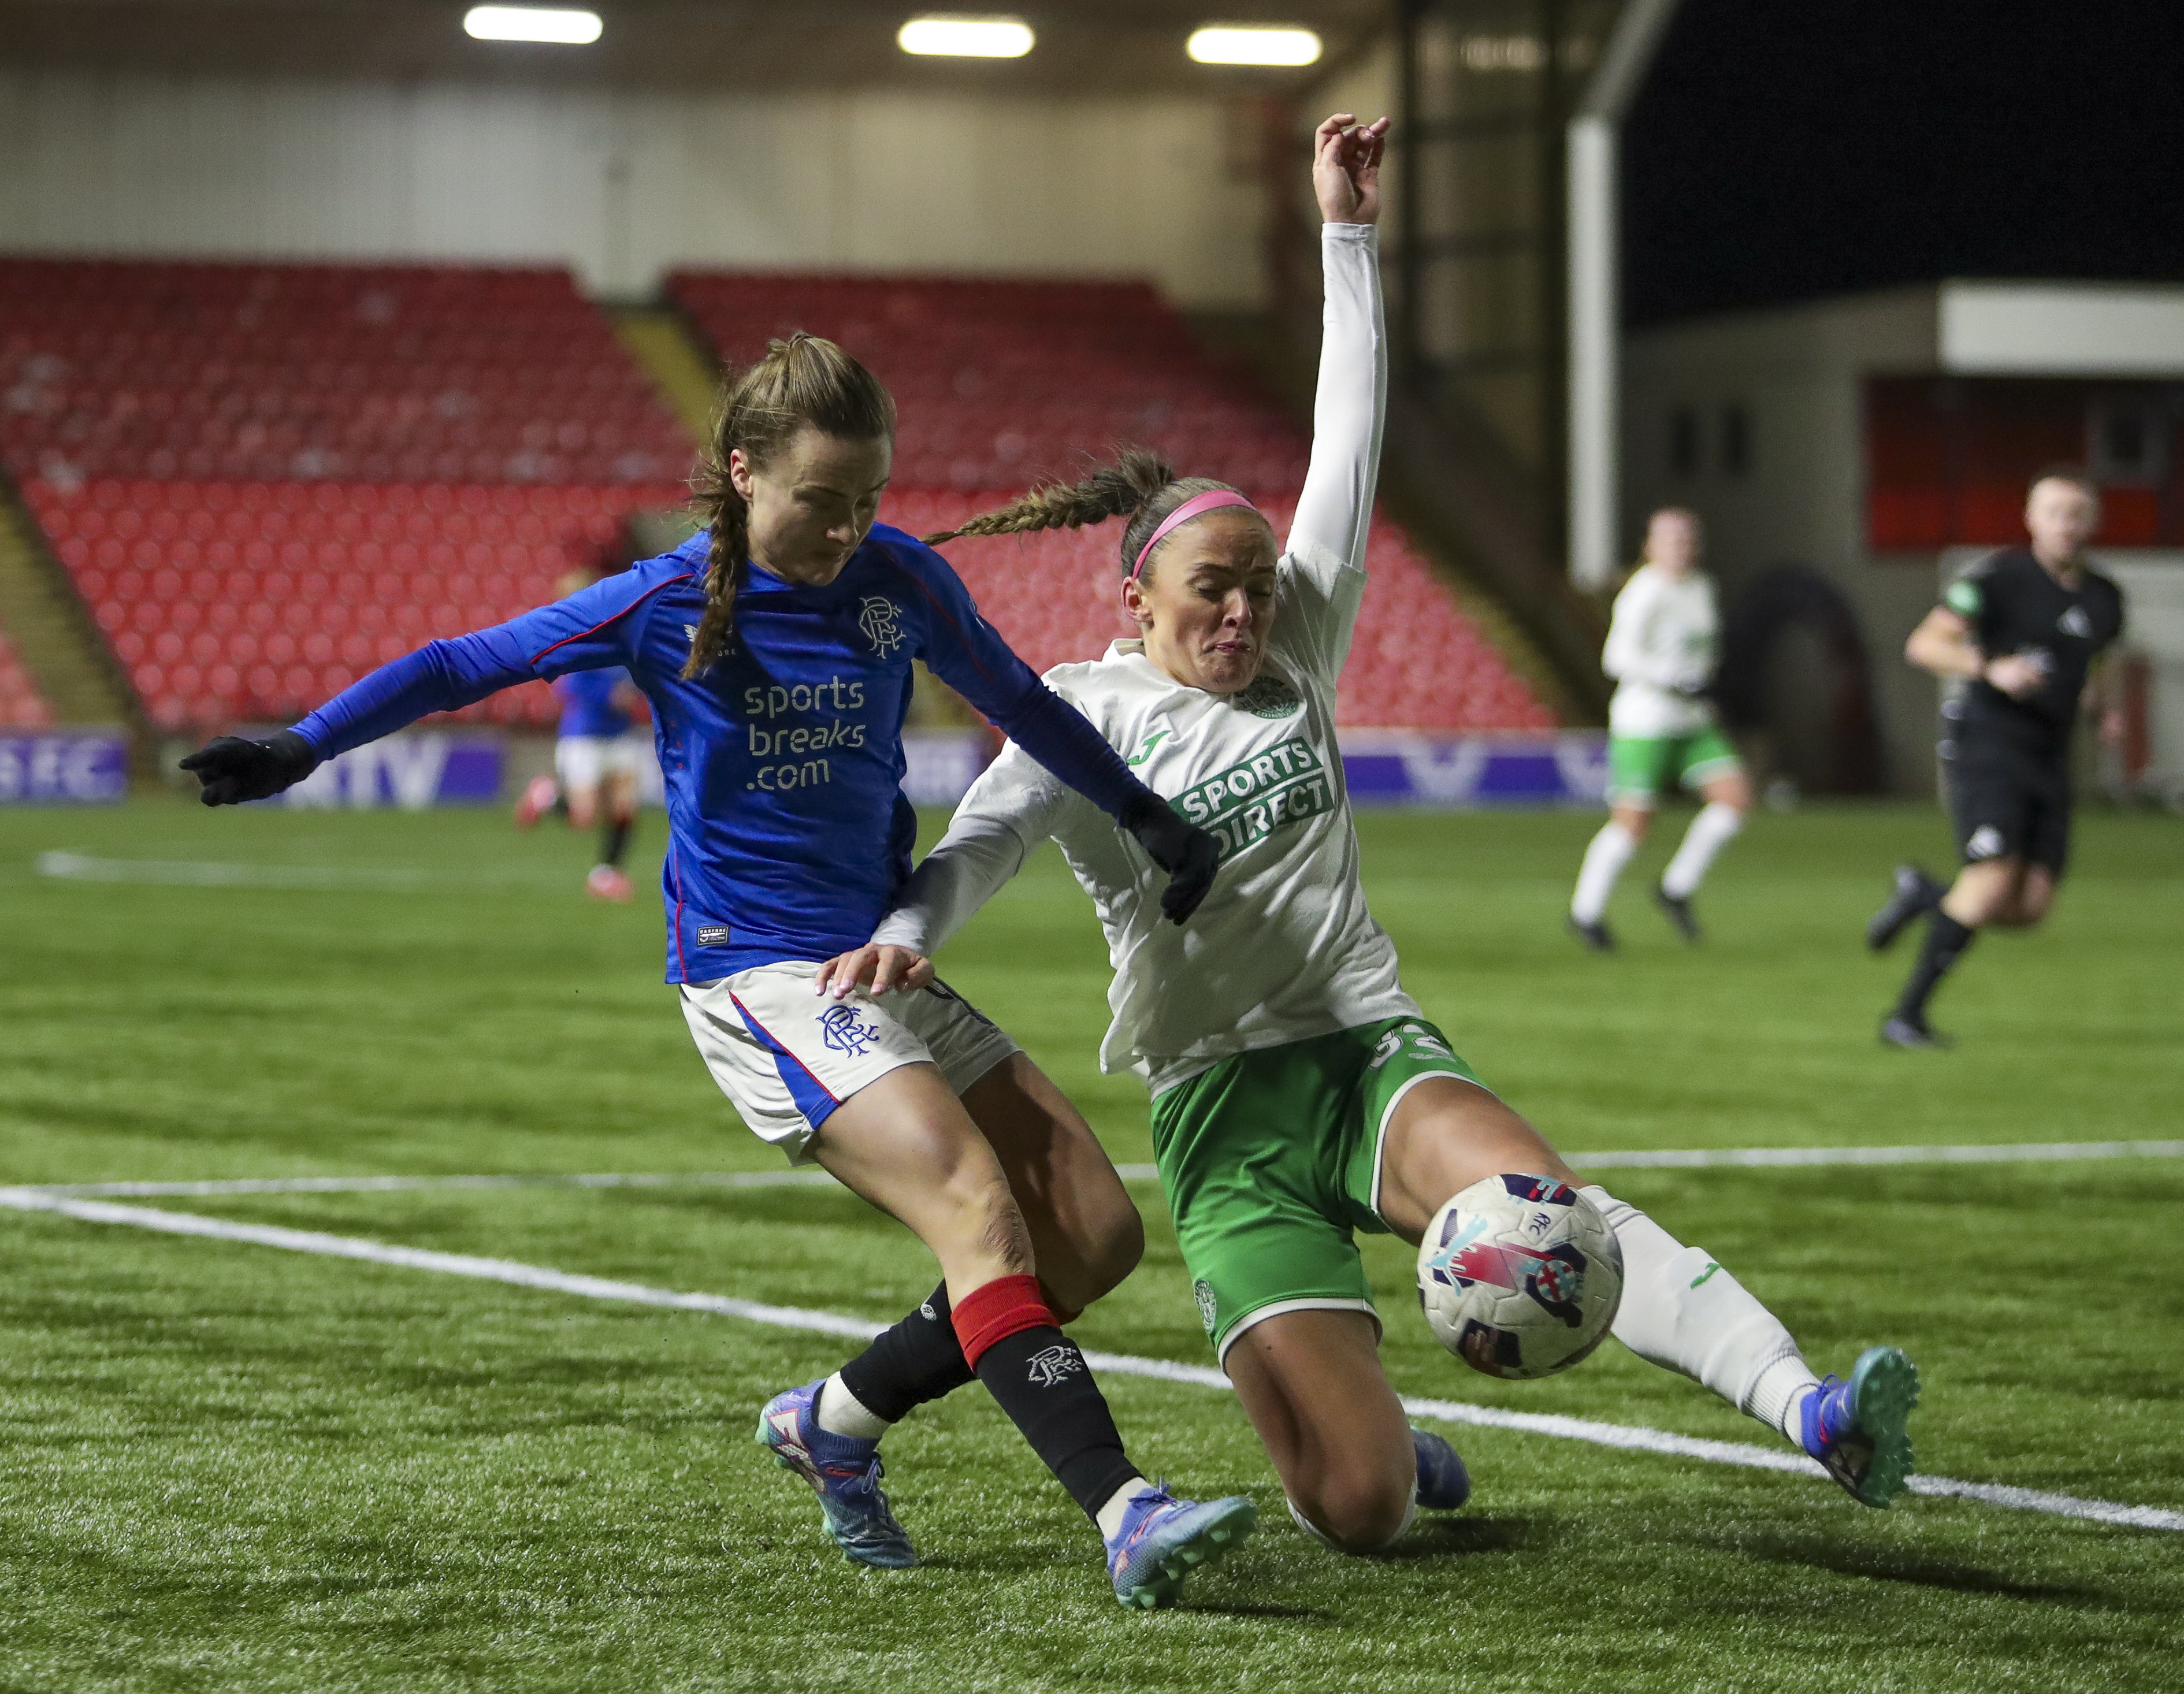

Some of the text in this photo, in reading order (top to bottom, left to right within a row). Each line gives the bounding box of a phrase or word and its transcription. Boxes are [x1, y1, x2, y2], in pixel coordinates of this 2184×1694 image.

[745, 675, 864, 718] sports
[749, 719, 866, 756] breaks
[746, 758, 830, 790] .com
[1182, 741, 1313, 823] SPORTS
